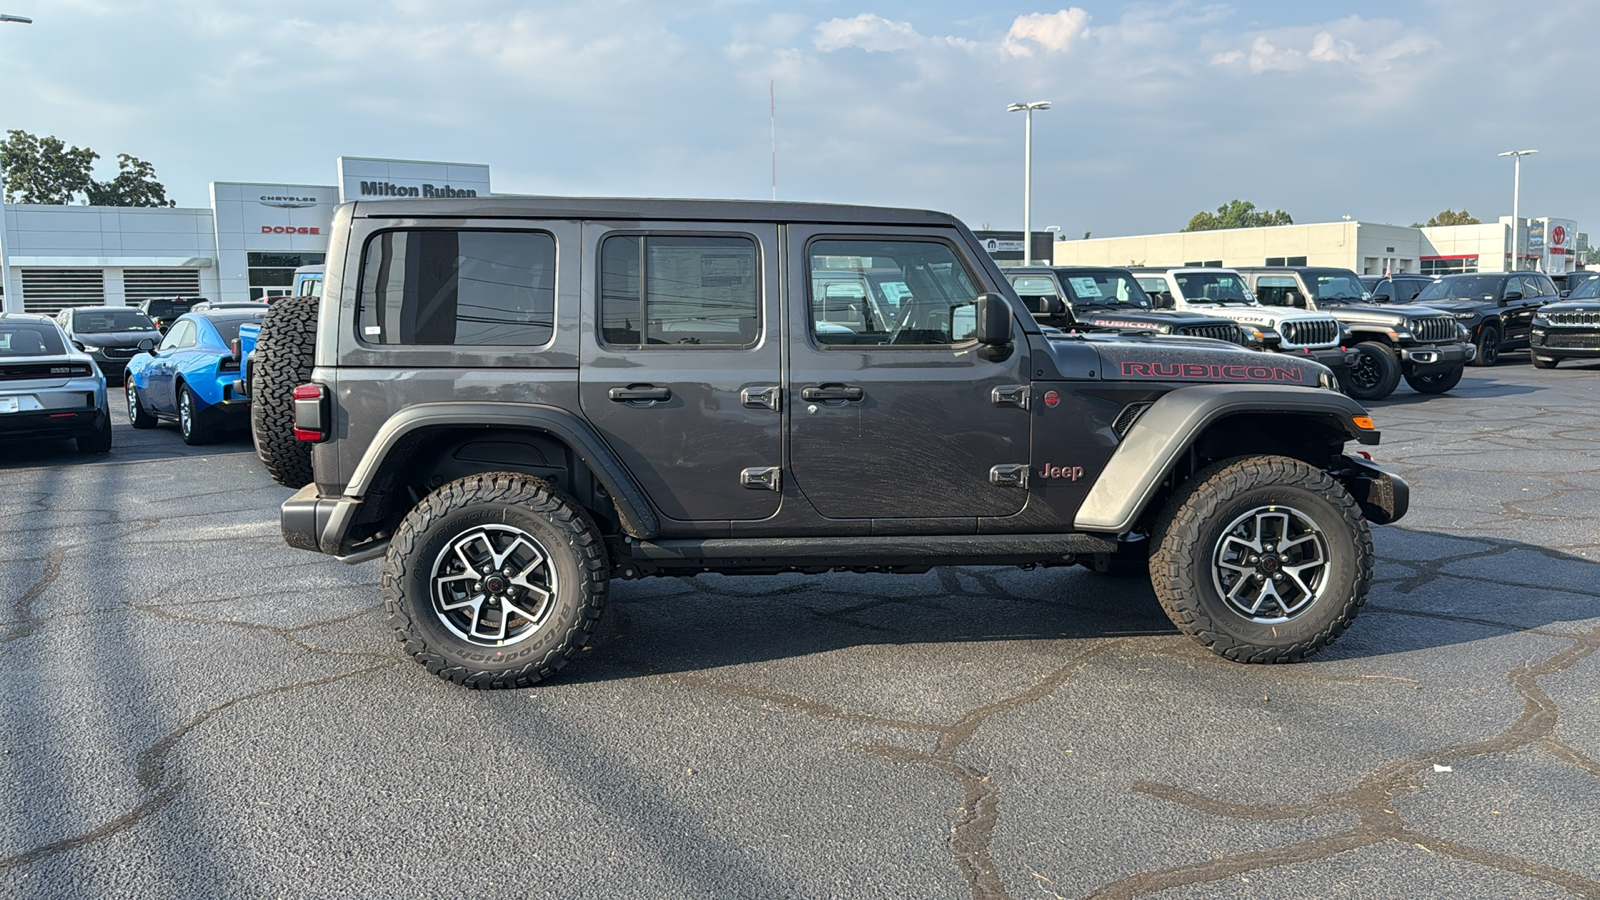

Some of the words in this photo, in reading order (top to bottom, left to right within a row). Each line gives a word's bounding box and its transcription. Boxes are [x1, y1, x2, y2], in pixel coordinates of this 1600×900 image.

[360, 181, 419, 198] Milton
[422, 184, 477, 198] Ruben
[261, 226, 320, 235] DODGE
[1094, 319, 1159, 329] RUBICON
[1121, 362, 1303, 382] RUBICON
[1038, 463, 1084, 481] Jeep
[456, 602, 572, 664] BFGoodrich
